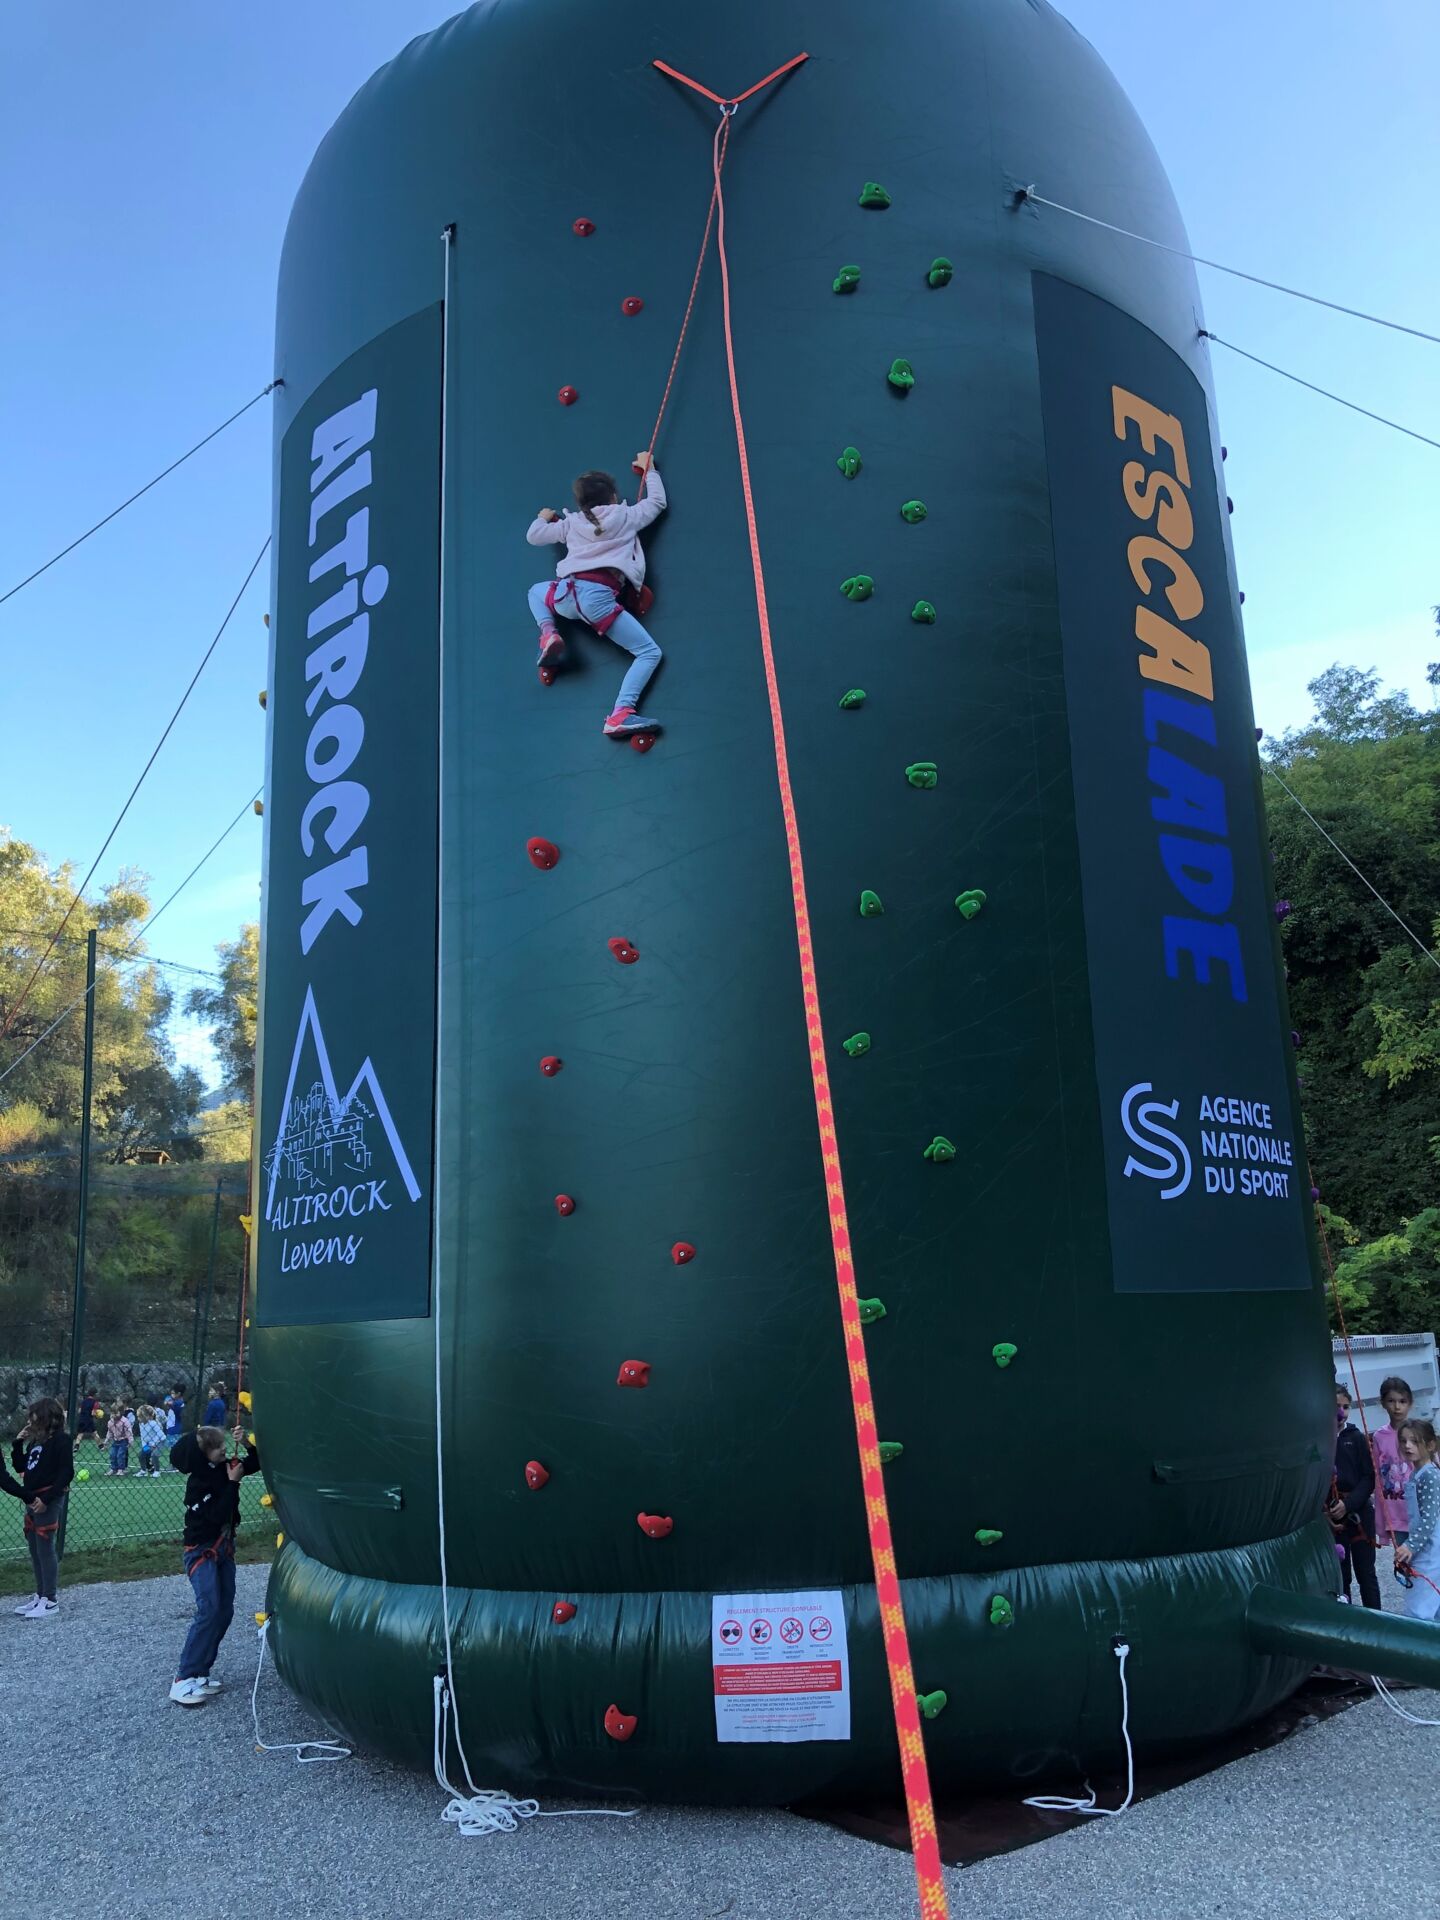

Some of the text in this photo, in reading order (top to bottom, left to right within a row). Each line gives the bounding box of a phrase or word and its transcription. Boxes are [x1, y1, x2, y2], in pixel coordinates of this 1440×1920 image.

[1111, 384, 1248, 1005] ESCALADE
[1199, 1095, 1273, 1130] AGENCE
[1201, 1130, 1293, 1167] NATIONALE
[1204, 1166, 1289, 1199] DU SPORT
[271, 1179, 392, 1232] ALTIROCK
[281, 1234, 363, 1273] Levens
